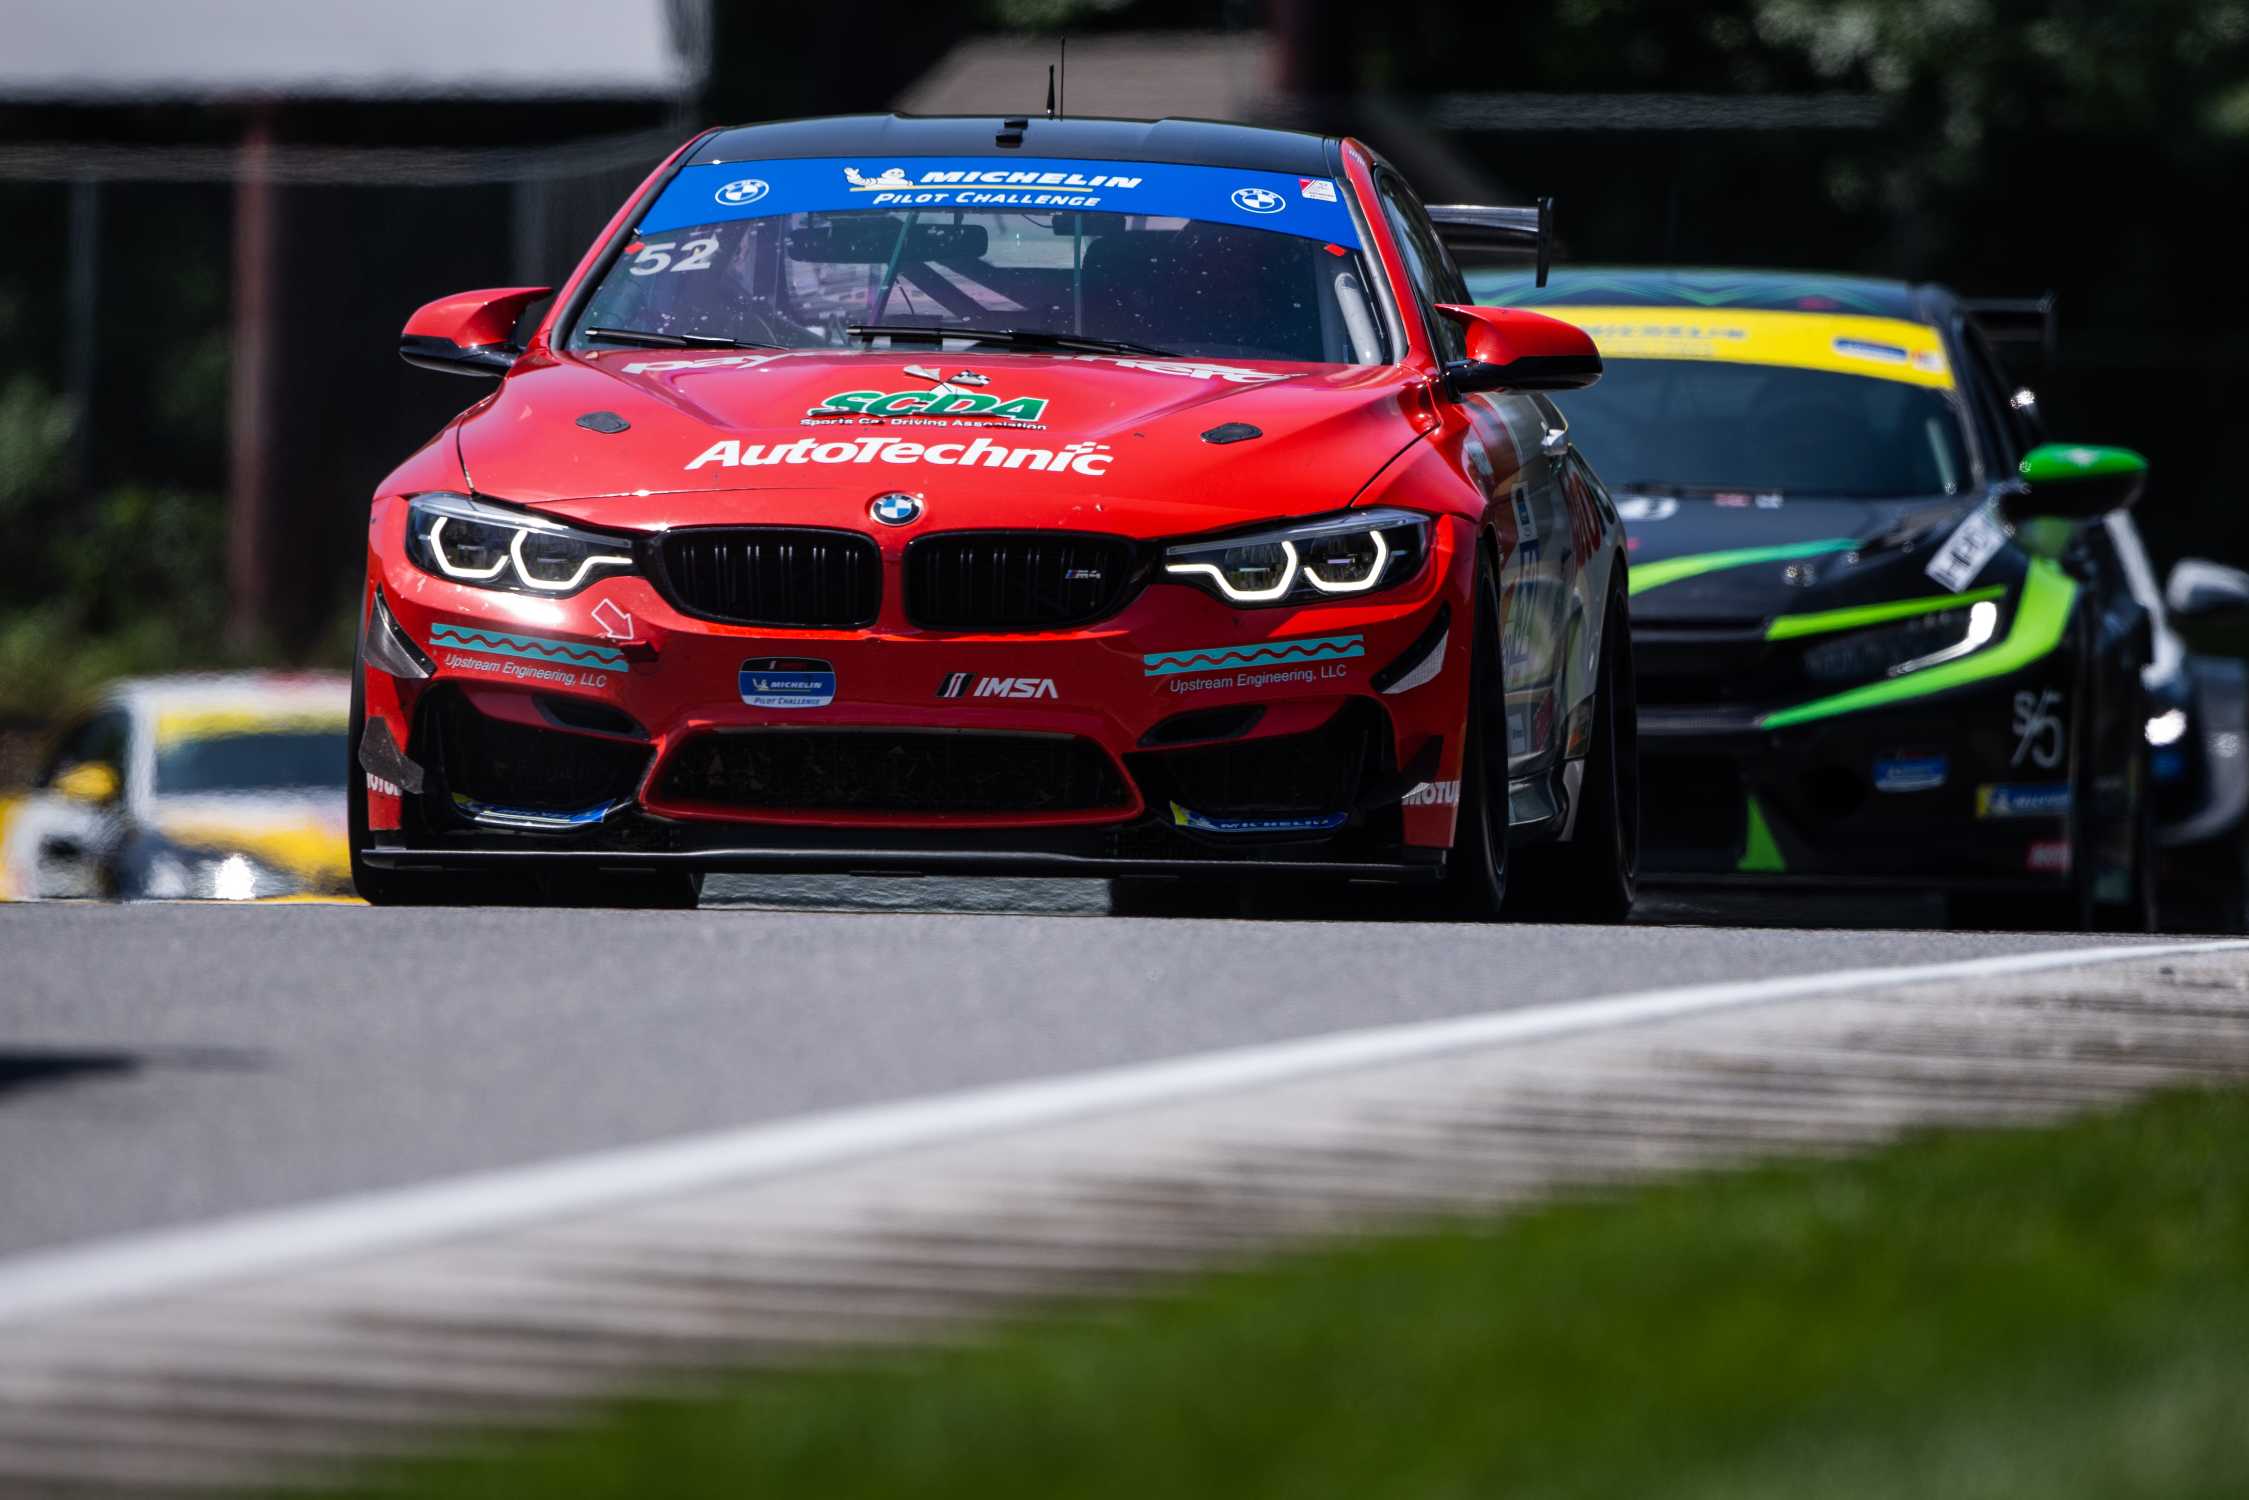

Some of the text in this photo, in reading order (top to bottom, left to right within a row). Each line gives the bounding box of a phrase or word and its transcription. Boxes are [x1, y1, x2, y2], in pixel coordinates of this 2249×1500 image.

[919, 170, 1143, 189] MICHELIN
[872, 191, 1102, 207] PILOT CHALLENGE
[629, 234, 720, 277] 52
[806, 390, 1049, 422] SCDA
[799, 417, 854, 427] Sports
[890, 417, 947, 428] Driving
[684, 437, 1115, 476] AutoTechnic
[444, 653, 500, 672] Upstream
[580, 673, 608, 688] LLC
[1169, 677, 1234, 694] Upstream
[1320, 663, 1347, 679] LLC
[769, 681, 823, 689] MICHELIN
[972, 677, 1059, 699] IMSA
